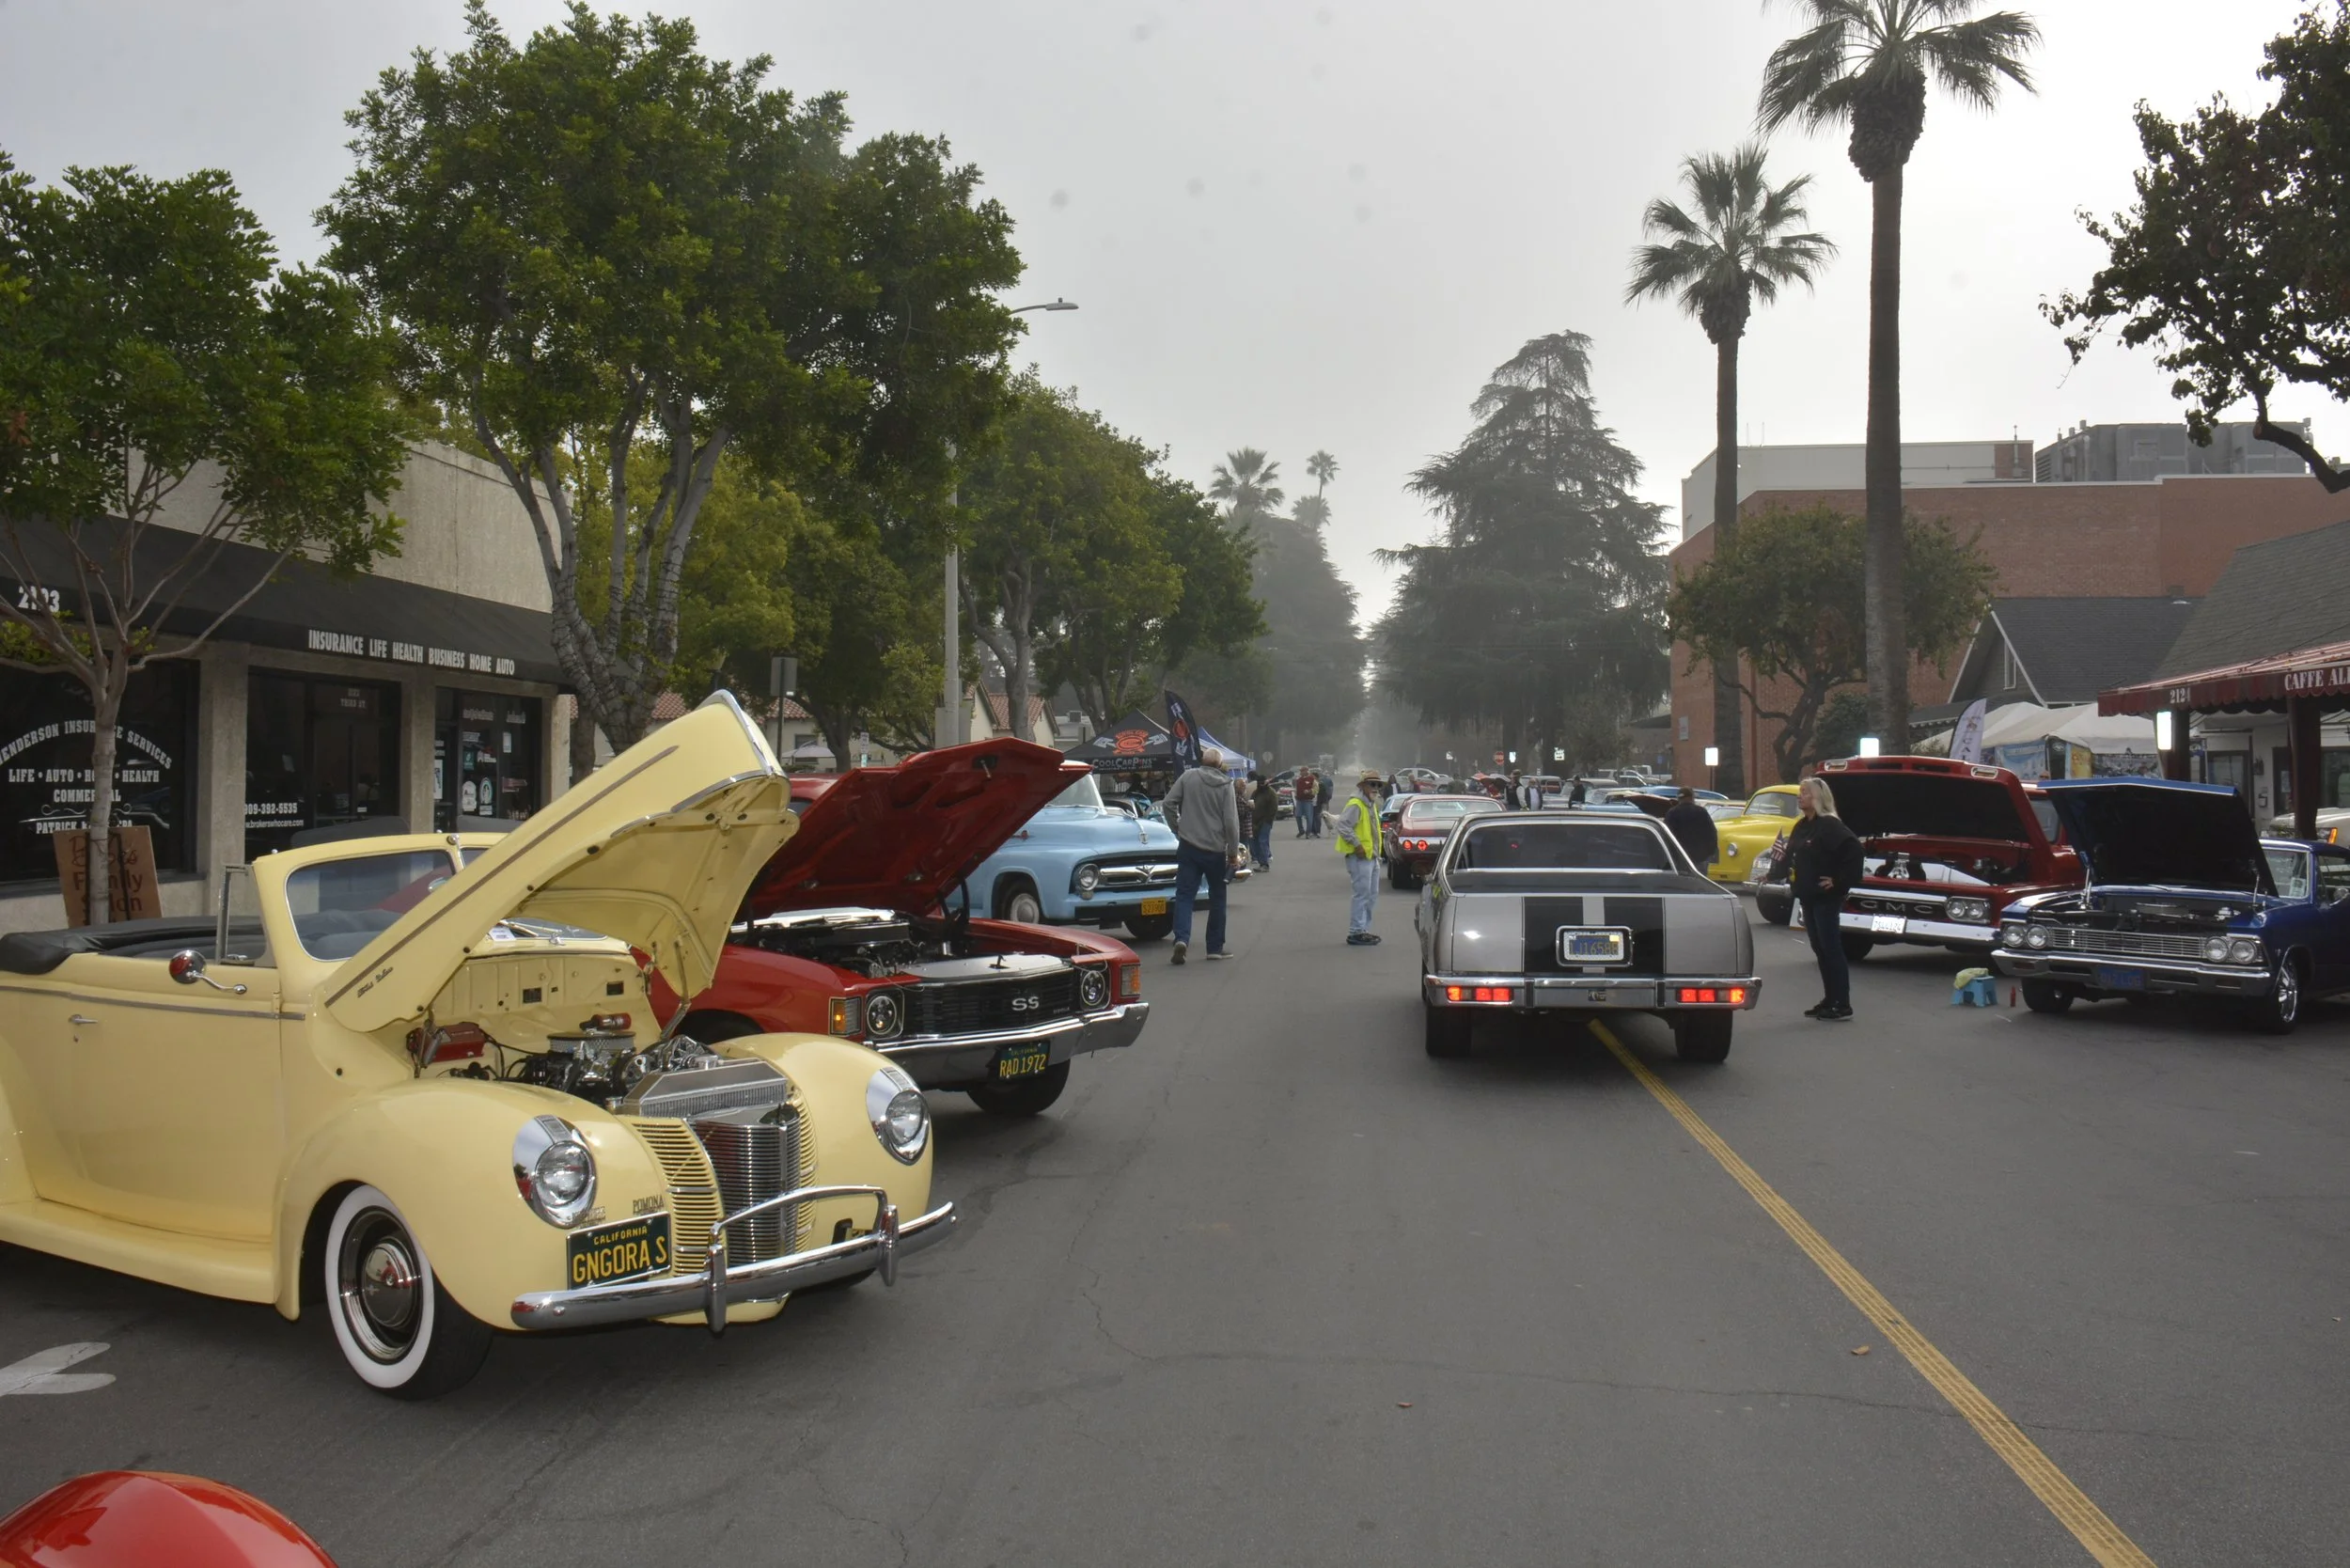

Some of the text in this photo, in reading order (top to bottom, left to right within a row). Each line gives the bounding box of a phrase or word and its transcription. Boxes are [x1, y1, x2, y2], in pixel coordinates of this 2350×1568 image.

[308, 629, 515, 676] INSURANCE LIFE HEALTH BUSINESS HOME AUTO
[2285, 669, 2324, 691] CAFFE
[127, 730, 172, 769] SERVICES
[8, 769, 35, 782] LIFE
[45, 769, 74, 782] AUTO
[122, 769, 160, 783] HEALTH
[1859, 900, 1934, 915] GMC
[1011, 996, 1040, 1011] SS
[633, 1196, 665, 1213] POMONA
[593, 1225, 648, 1246] CALIFORNIA
[572, 1235, 667, 1283] GNGORA S
